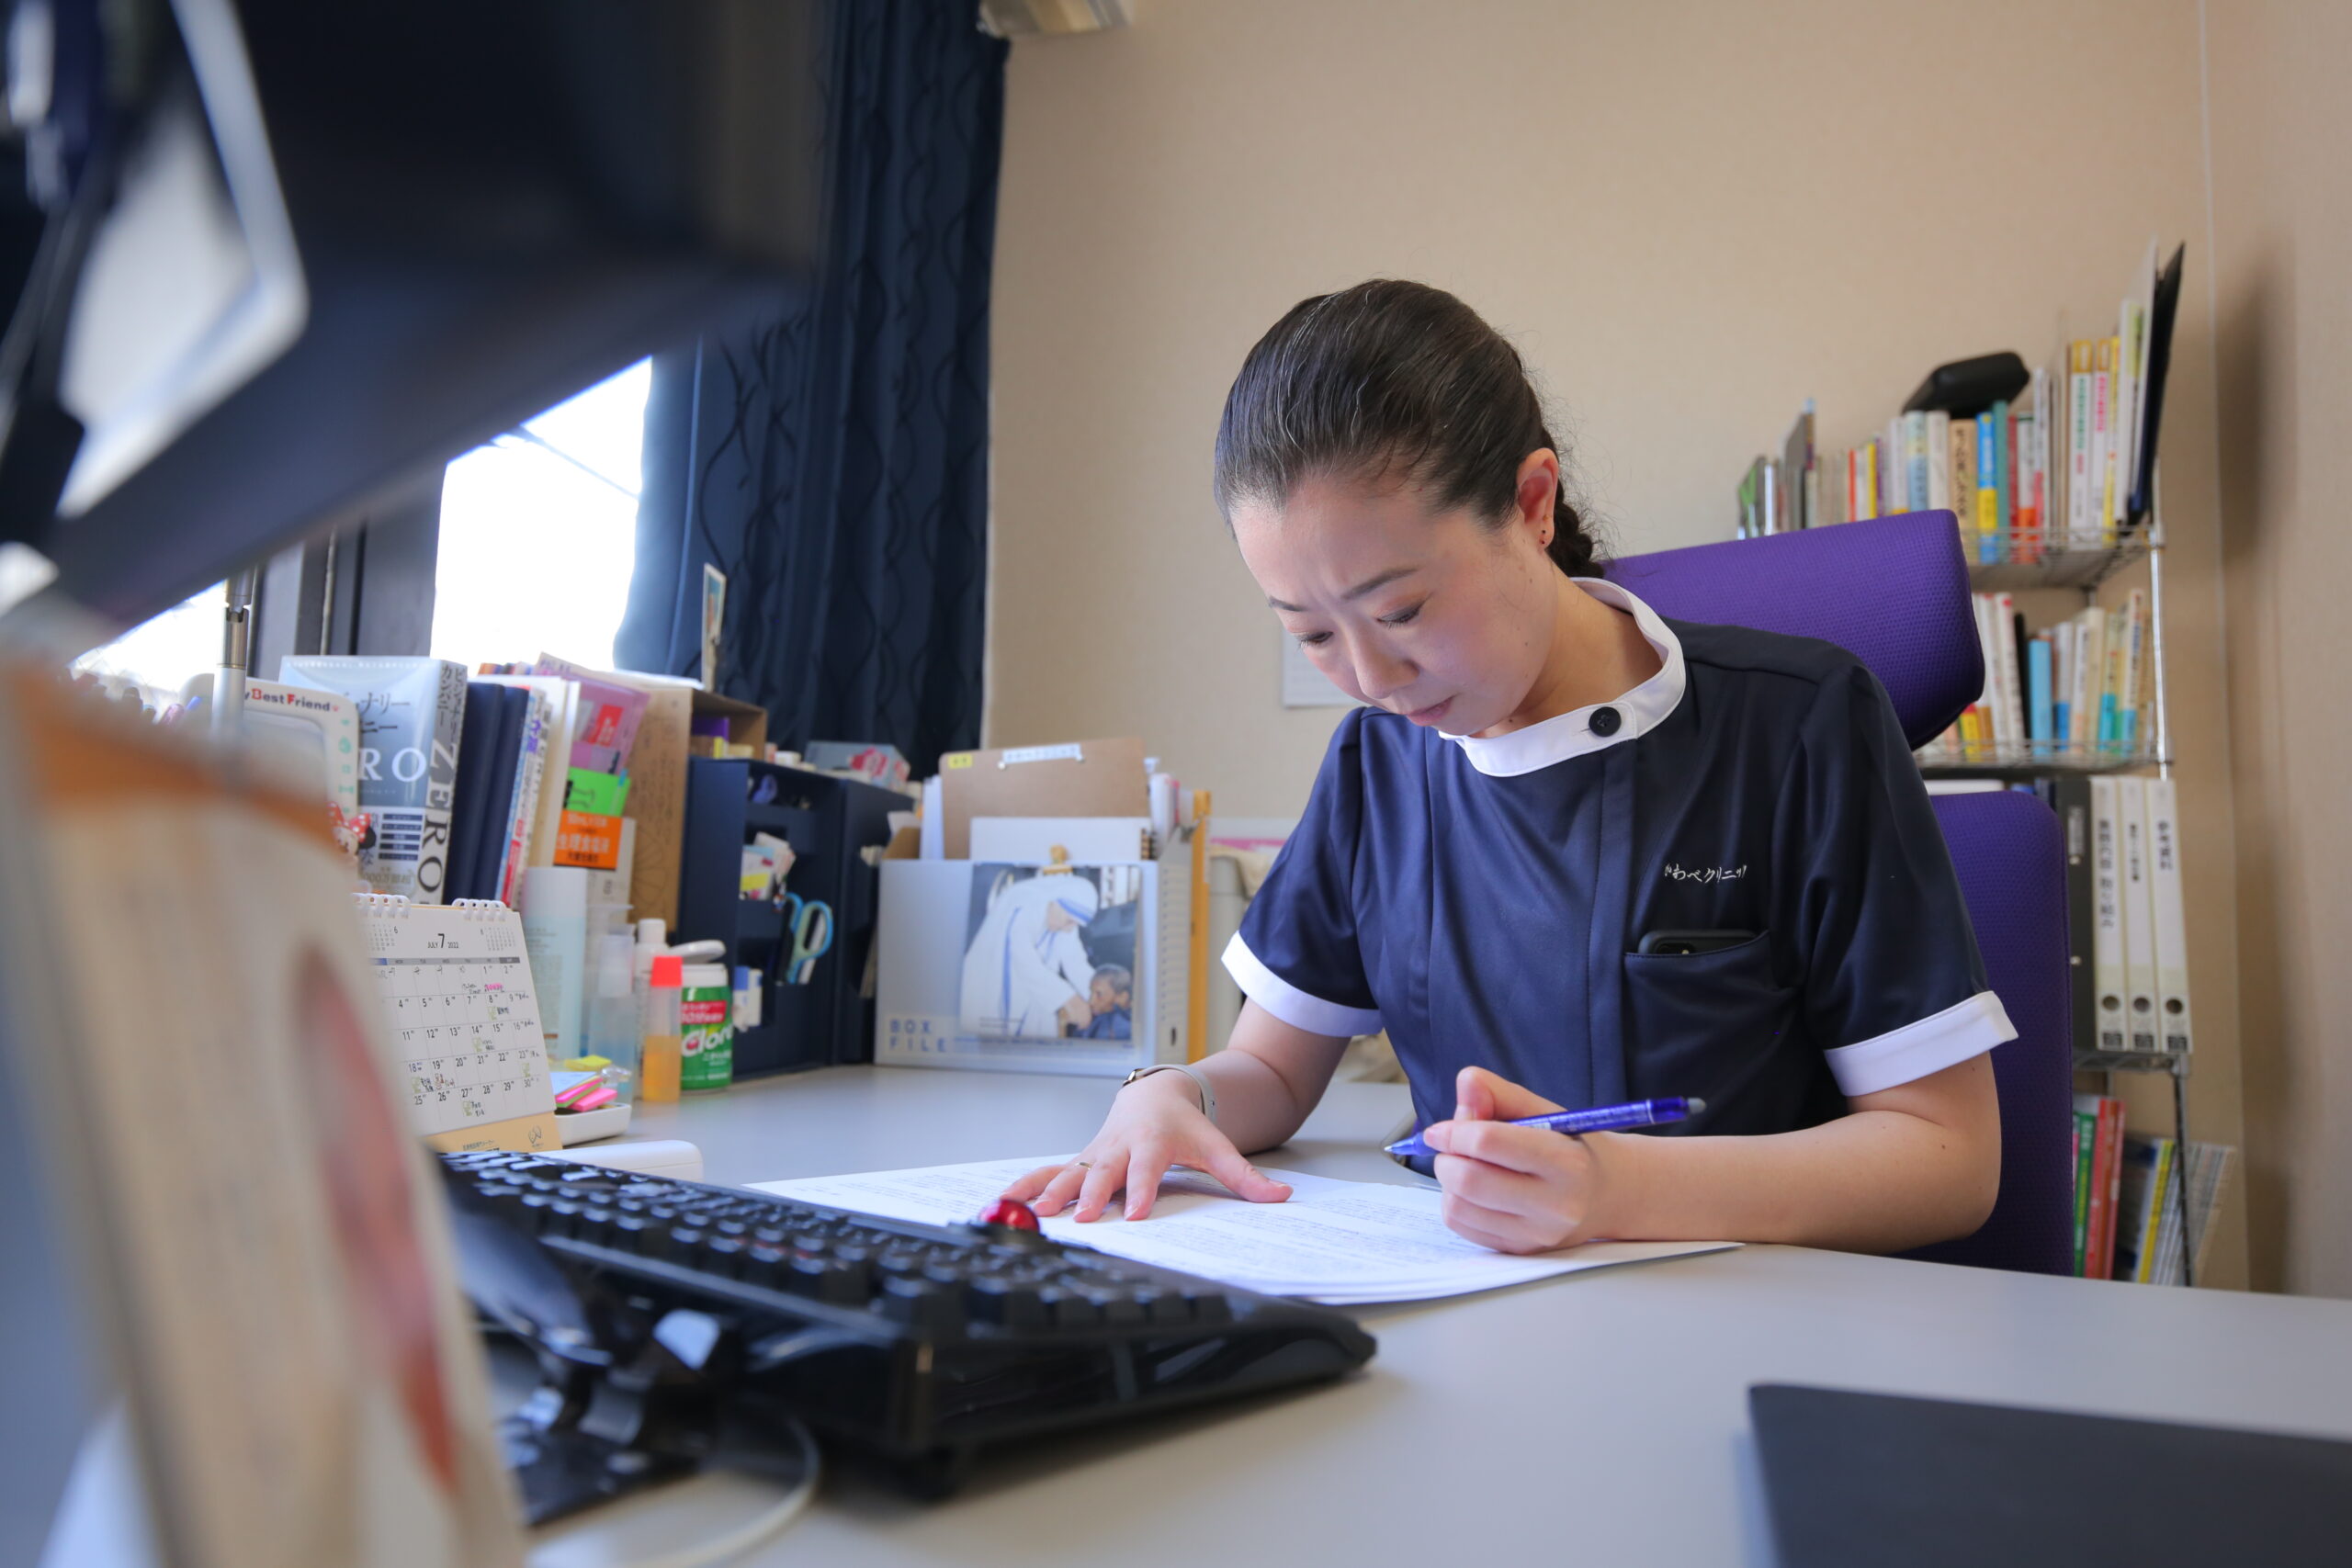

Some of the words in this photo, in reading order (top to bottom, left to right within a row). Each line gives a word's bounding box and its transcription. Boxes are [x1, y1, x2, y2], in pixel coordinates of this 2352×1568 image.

[252, 688, 285, 704] Best
[287, 694, 331, 712] Friend
[436, 664, 452, 728] カンパニー
[358, 747, 427, 783] RO
[418, 739, 458, 893] ZERO
[437, 933, 445, 949] 7
[888, 1018, 933, 1034] BOX
[888, 1037, 948, 1054] FILE
